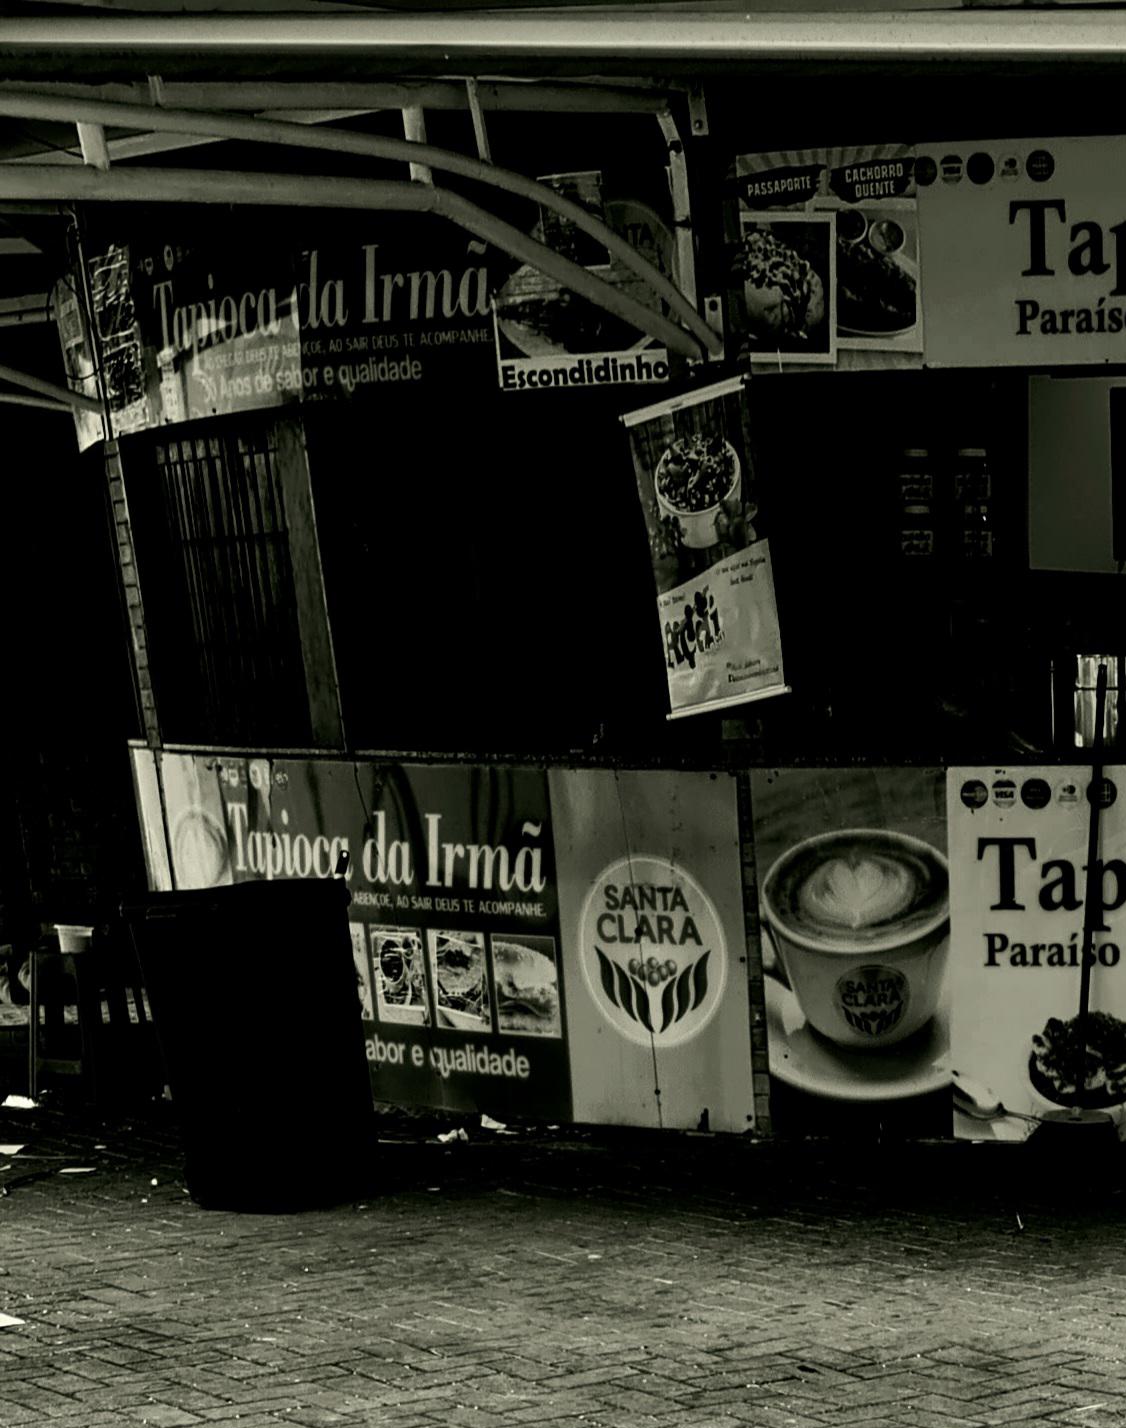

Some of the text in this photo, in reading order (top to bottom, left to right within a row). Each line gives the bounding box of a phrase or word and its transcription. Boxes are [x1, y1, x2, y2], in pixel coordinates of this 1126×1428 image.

[747, 174, 813, 198] PASSAPORTE
[845, 163, 904, 184] CACHORRO
[854, 180, 896, 201] QUENTE
[153, 239, 494, 376] Tapioca da Irmã
[328, 339, 344, 354] AO
[347, 336, 370, 352] SAIR
[371, 334, 400, 351] DEUS
[403, 335, 416, 347] TE
[419, 328, 494, 347] ACOMPANHE.
[276, 364, 319, 391] sabor
[322, 365, 335, 386] e
[337, 353, 423, 394] qualidade
[501, 354, 669, 388] Escondidinho
[227, 802, 547, 893] Tapioca da Irmã
[396, 895, 409, 909] AO
[412, 896, 433, 910] SAIR
[435, 897, 461, 913] DEUS
[464, 899, 475, 914] TE
[478, 900, 547, 917] ACOMPANHE.
[604, 884, 689, 913] SANTA
[596, 912, 703, 946] CLARA
[983, 933, 1120, 967] Paraíso
[842, 988, 901, 1007] CLARA
[846, 979, 898, 994] SANTA
[364, 1032, 531, 1079] abor e qualidade
